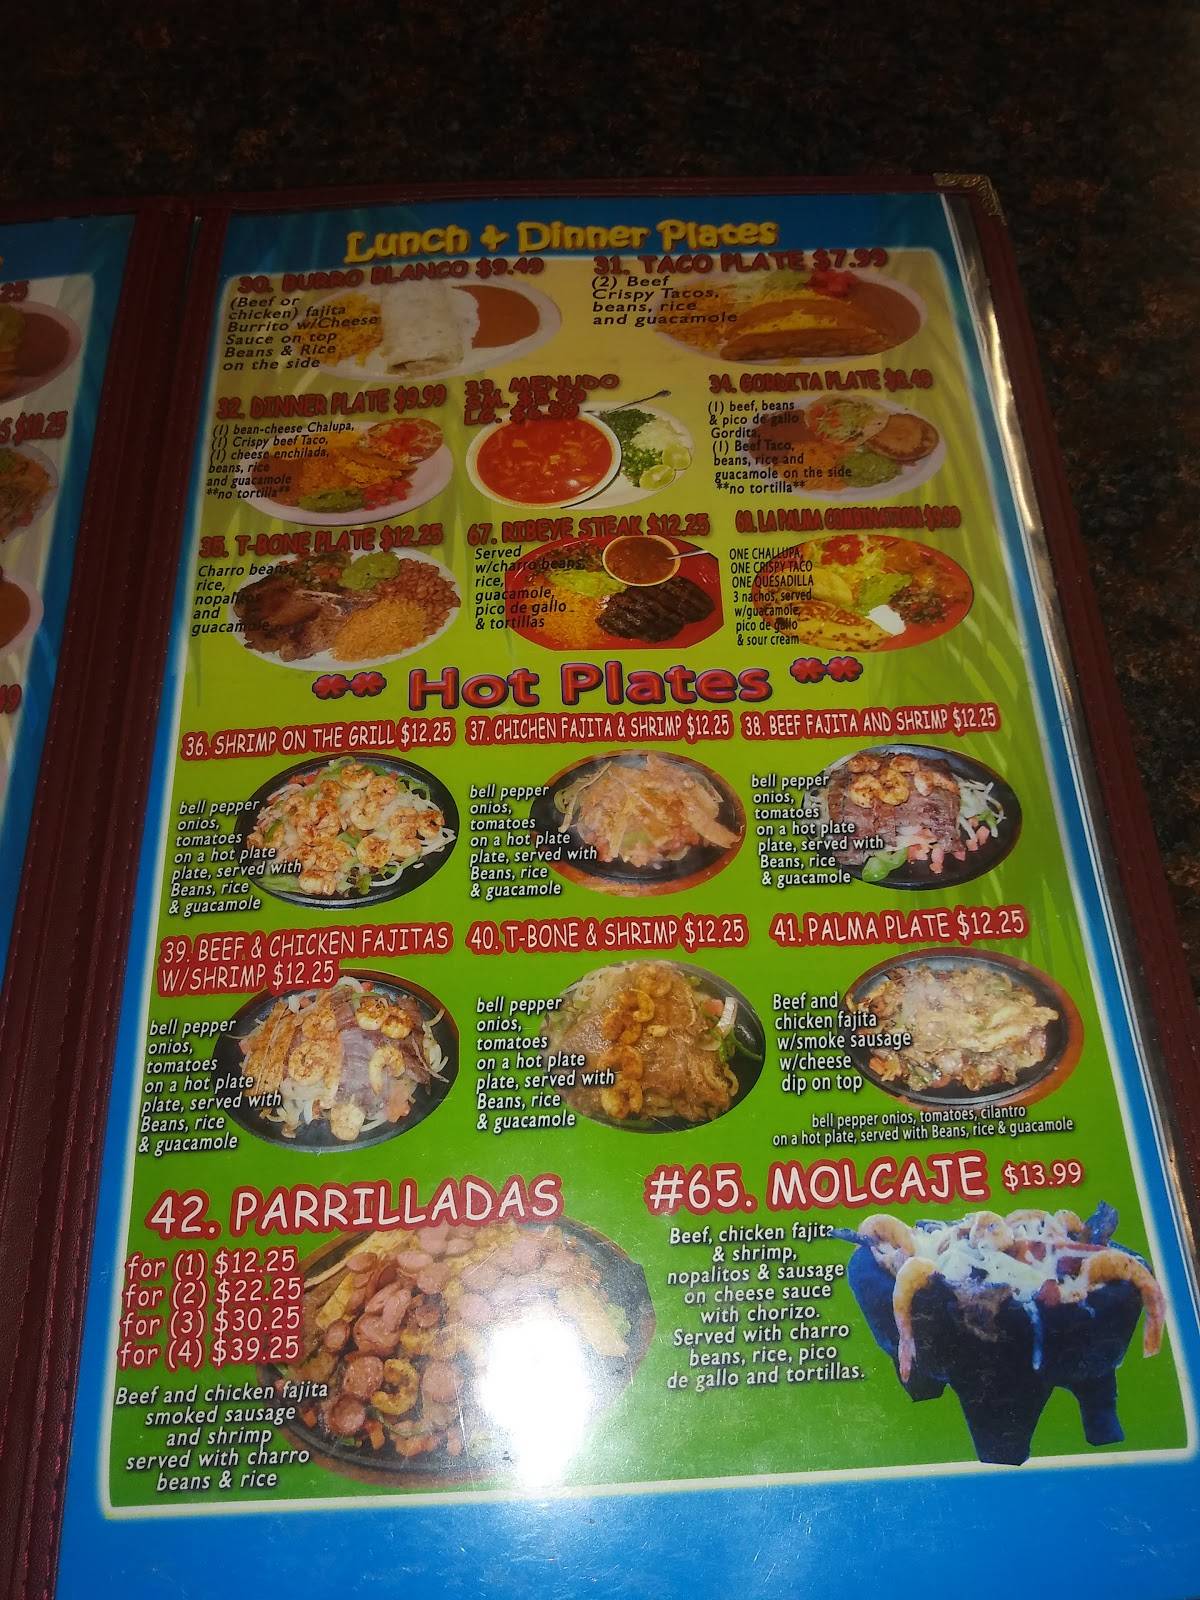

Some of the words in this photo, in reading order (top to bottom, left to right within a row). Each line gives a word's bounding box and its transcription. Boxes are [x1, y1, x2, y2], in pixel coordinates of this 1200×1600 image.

[343, 224, 471, 264] Lunch
[516, 221, 651, 253] Dinner
[655, 220, 779, 251] Plates
[594, 256, 631, 276] 31.
[638, 255, 713, 274] TACO
[720, 251, 804, 273] PLATE
[812, 249, 888, 272] $7.99
[282, 269, 364, 292] BURRO
[370, 260, 469, 285] BLANCO
[475, 256, 545, 279] $9.49
[592, 275, 617, 289] (2)
[627, 275, 671, 287] Beef
[592, 287, 654, 301] Crispy
[662, 287, 719, 299] Tacos,
[228, 307, 298, 321] chicken)
[305, 305, 346, 318] fajita
[592, 300, 652, 313] beans,
[660, 300, 696, 311] rice
[227, 321, 289, 332] Burrito
[297, 315, 378, 329] w/Cheese
[593, 313, 627, 325] and
[635, 311, 738, 327] guacamole
[223, 361, 244, 371] on
[252, 360, 278, 370] the
[286, 358, 320, 368] side
[509, 374, 620, 393] MENUDO
[709, 374, 737, 393] 34.
[825, 369, 880, 391] PLATE
[250, 395, 327, 419] DINNER
[330, 389, 390, 415] PLATE
[233, 424, 303, 435] bean-cheese
[307, 421, 355, 433] Chalupa,
[233, 436, 268, 449] Crispy
[273, 436, 299, 446] beef
[301, 435, 328, 445] Taco,
[714, 468, 778, 483] guacamole
[783, 469, 798, 478] on
[804, 467, 823, 477] the
[828, 466, 851, 477] side
[467, 523, 497, 546] 67.
[502, 517, 573, 543] RIBEYE
[579, 516, 643, 539] STEAK
[647, 513, 710, 536] $12.25
[235, 531, 311, 556] T-BONE
[314, 528, 376, 552] PLATE
[380, 523, 443, 552] $12.25
[475, 546, 521, 560] Served
[729, 548, 749, 560] ONE
[751, 546, 803, 559] CHALLUPA,
[197, 580, 225, 591] rice,
[732, 576, 752, 588] ONE
[755, 574, 814, 587] QUESADILLA
[476, 618, 485, 630] &
[490, 616, 545, 629] tortillas
[407, 666, 540, 711] Hot
[560, 660, 773, 706] Plates
[470, 721, 489, 741] 37.
[495, 718, 556, 740] CHICHEN
[561, 717, 612, 738] FAJITA
[618, 717, 625, 737] &
[631, 715, 681, 737] SHRIMP
[687, 714, 730, 737] $12.25
[745, 716, 765, 736] 38.
[769, 714, 801, 735] BEEF
[806, 712, 858, 733] FAJITA
[863, 712, 891, 732] AND
[896, 709, 947, 730] SHRIMP
[952, 706, 996, 729] $12.25
[185, 736, 207, 756] 36.
[214, 733, 276, 754] SHRIMP
[282, 730, 306, 750] ON
[313, 727, 342, 748] THE
[348, 724, 394, 746] GRILL
[400, 721, 451, 746] $12.25
[179, 801, 206, 815] bell
[210, 799, 260, 816] pepper
[178, 817, 219, 831] onios,
[176, 832, 242, 847] tomatoes
[470, 835, 488, 847] on
[493, 835, 500, 846] a
[506, 832, 530, 845] hot
[536, 832, 571, 849] plate
[759, 839, 796, 855] plate,
[801, 837, 847, 850] served
[853, 836, 884, 849] with
[171, 882, 216, 897] Beans,
[221, 882, 249, 894] rice
[471, 926, 498, 949] 40.
[506, 923, 579, 948] T-BONE
[586, 922, 597, 946] &
[604, 920, 677, 945] SHRIMP
[685, 918, 744, 947] $12.25
[774, 919, 802, 942] 41.
[808, 916, 879, 941] PALMA
[886, 913, 950, 938] PLATE
[957, 910, 1024, 939] $12.25
[164, 941, 189, 963] 39.
[199, 937, 244, 962] BEEF
[251, 937, 262, 958] &
[269, 932, 355, 958] CHICKEN
[362, 927, 448, 952] FAJITAS
[162, 964, 266, 991] W/SHRIMP
[273, 960, 334, 986] $12.25
[476, 1017, 522, 1031] onios,
[774, 1013, 832, 1030] chicken
[838, 1012, 877, 1029] fajita
[778, 1034, 845, 1050] w/smoke
[850, 1032, 912, 1053] sausage
[146, 1058, 218, 1074] tomatoes
[780, 1055, 852, 1070] w/cheese
[477, 1093, 526, 1110] Beans,
[530, 1092, 560, 1106] rice
[812, 1114, 833, 1128] bell
[838, 1114, 877, 1130] pepper
[882, 1112, 916, 1125] onios,
[920, 1109, 977, 1122] tomatoes,
[981, 1106, 1026, 1119] cilantro
[139, 1140, 149, 1152] &
[154, 1134, 238, 1156] guacamole
[649, 1169, 752, 1210] #65.
[771, 1157, 984, 1205] MOLCAJE
[1003, 1162, 1081, 1190] $13.99
[150, 1195, 216, 1235] 42.
[235, 1180, 559, 1231] PARRILLADAS
[127, 1256, 166, 1280] for
[174, 1253, 206, 1282] (1)
[215, 1249, 295, 1279] $12.25
[668, 1267, 750, 1288] nopalitos
[757, 1265, 771, 1280] &
[777, 1263, 844, 1282] sausage
[124, 1284, 163, 1308] for
[172, 1282, 207, 1309] (2)
[217, 1278, 302, 1305] $22.25
[121, 1312, 161, 1338] for
[170, 1309, 205, 1339] (3)
[216, 1306, 300, 1336] $30.25
[701, 1306, 739, 1323] with
[747, 1304, 820, 1321] chorizo.
[120, 1343, 159, 1366] for
[167, 1340, 203, 1369] (4)
[213, 1336, 299, 1366] $39.25
[668, 1373, 688, 1390] de
[695, 1371, 739, 1393] gallo
[746, 1368, 779, 1383] and
[786, 1363, 865, 1382] tortillas.
[145, 1406, 218, 1425] smoked
[225, 1405, 295, 1424] sausage
